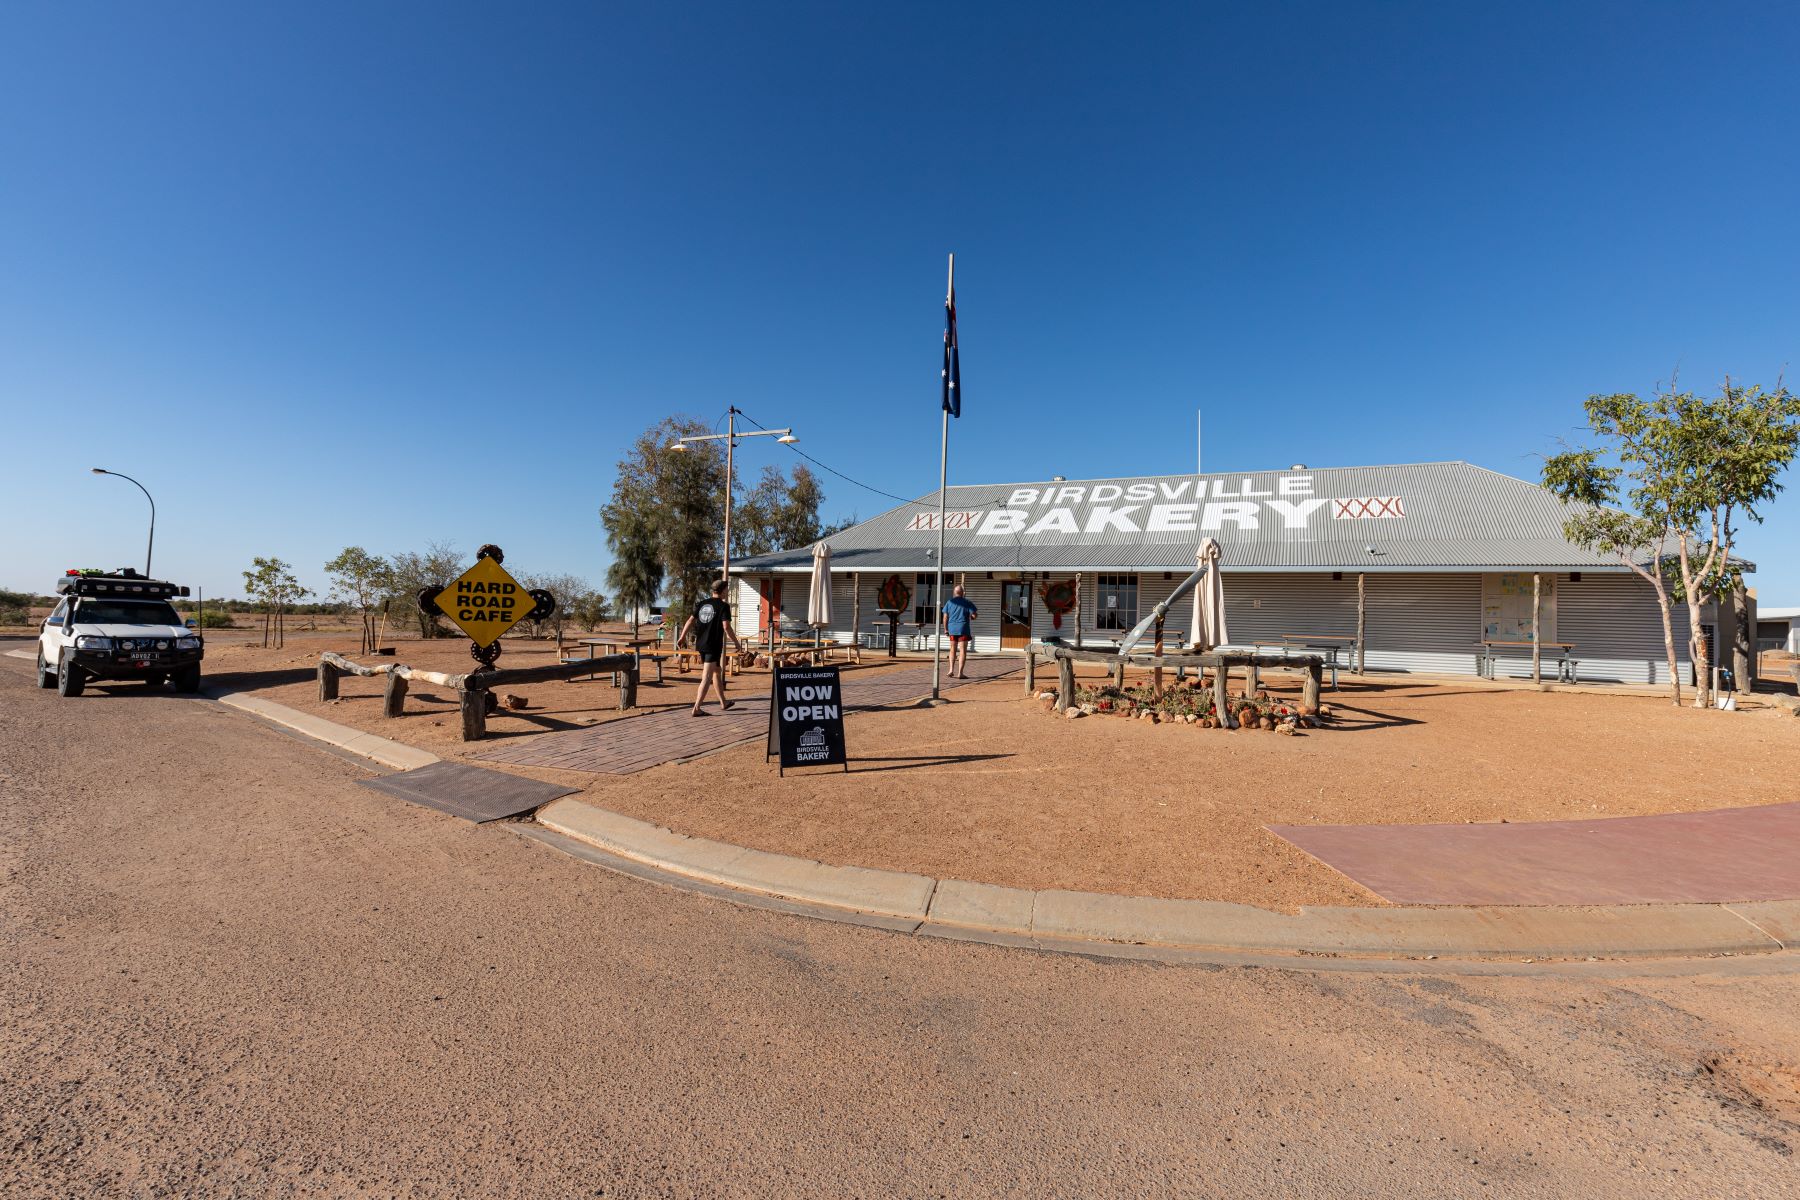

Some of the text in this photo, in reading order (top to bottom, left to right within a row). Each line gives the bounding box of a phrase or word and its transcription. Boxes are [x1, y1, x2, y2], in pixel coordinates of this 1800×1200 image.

[1006, 475, 1314, 506] BIRDSVILLE
[976, 498, 1330, 536] BAKERY
[457, 581, 516, 595] HARD
[456, 595, 516, 609] ROAD
[458, 609, 513, 623] CAFE
[785, 685, 833, 702] NOW
[782, 704, 839, 722] OPEN
[796, 745, 830, 753] BIRDSVILLE
[797, 751, 830, 761] BAKERY
